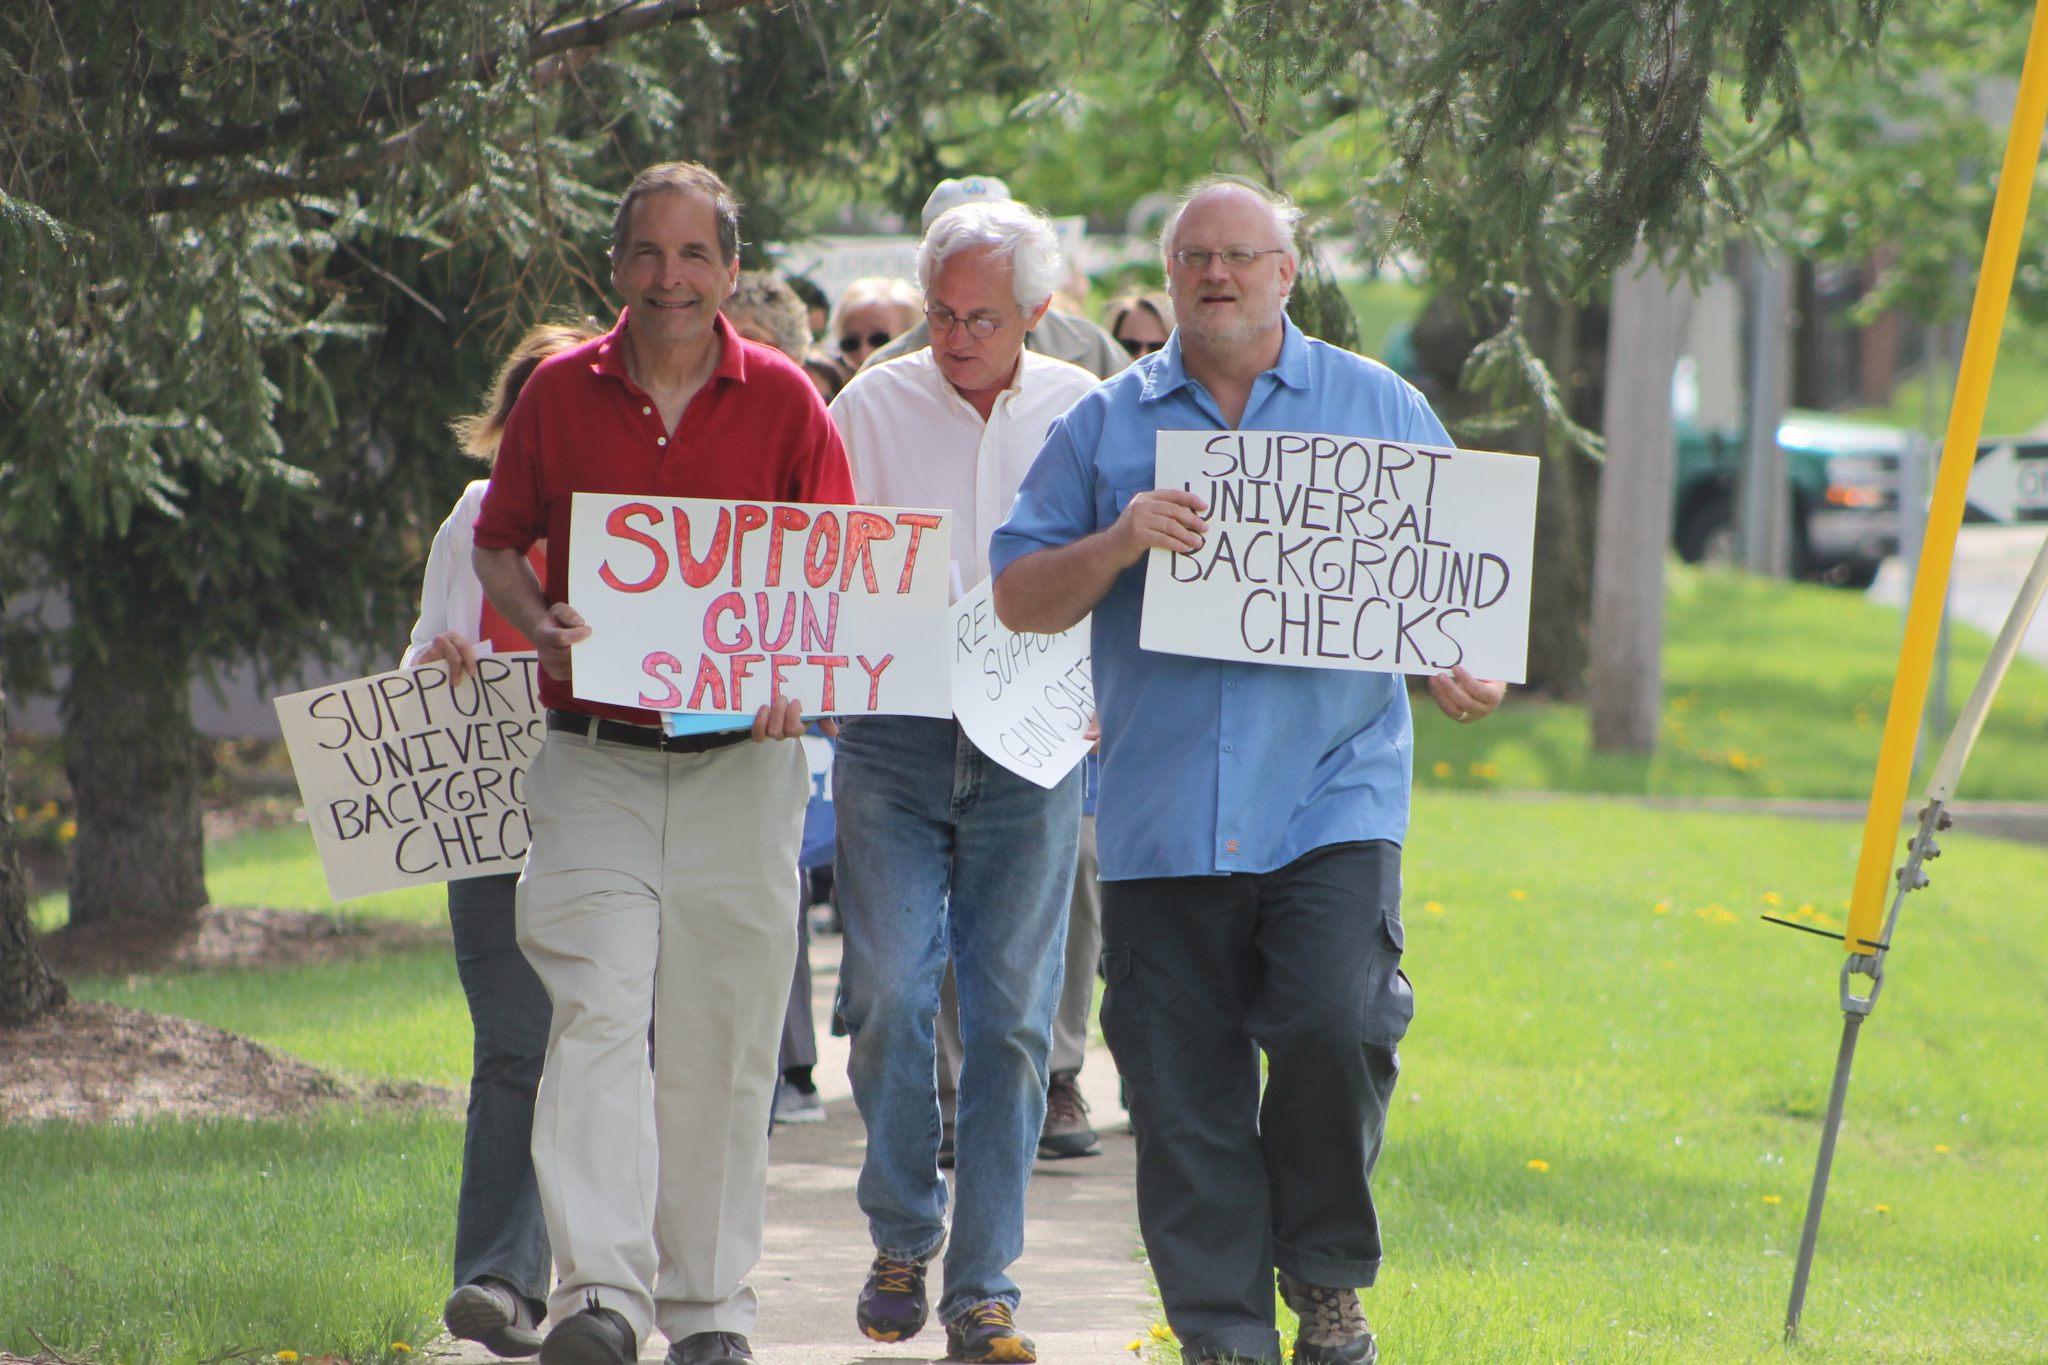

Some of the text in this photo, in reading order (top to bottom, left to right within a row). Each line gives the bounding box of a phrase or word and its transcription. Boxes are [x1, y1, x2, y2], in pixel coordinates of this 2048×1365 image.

[1201, 434, 1452, 506] SUPPORT
[597, 502, 942, 594] SUPPORT
[1184, 478, 1452, 548] UNIVERSAL
[1170, 530, 1511, 609] BACKGROUND
[702, 590, 840, 655] GUN
[956, 598, 997, 664] RE
[1239, 588, 1471, 669] CHECKS
[308, 657, 539, 750] SUPPORT
[638, 650, 895, 712] SAFETY
[999, 705, 1066, 769] GUN
